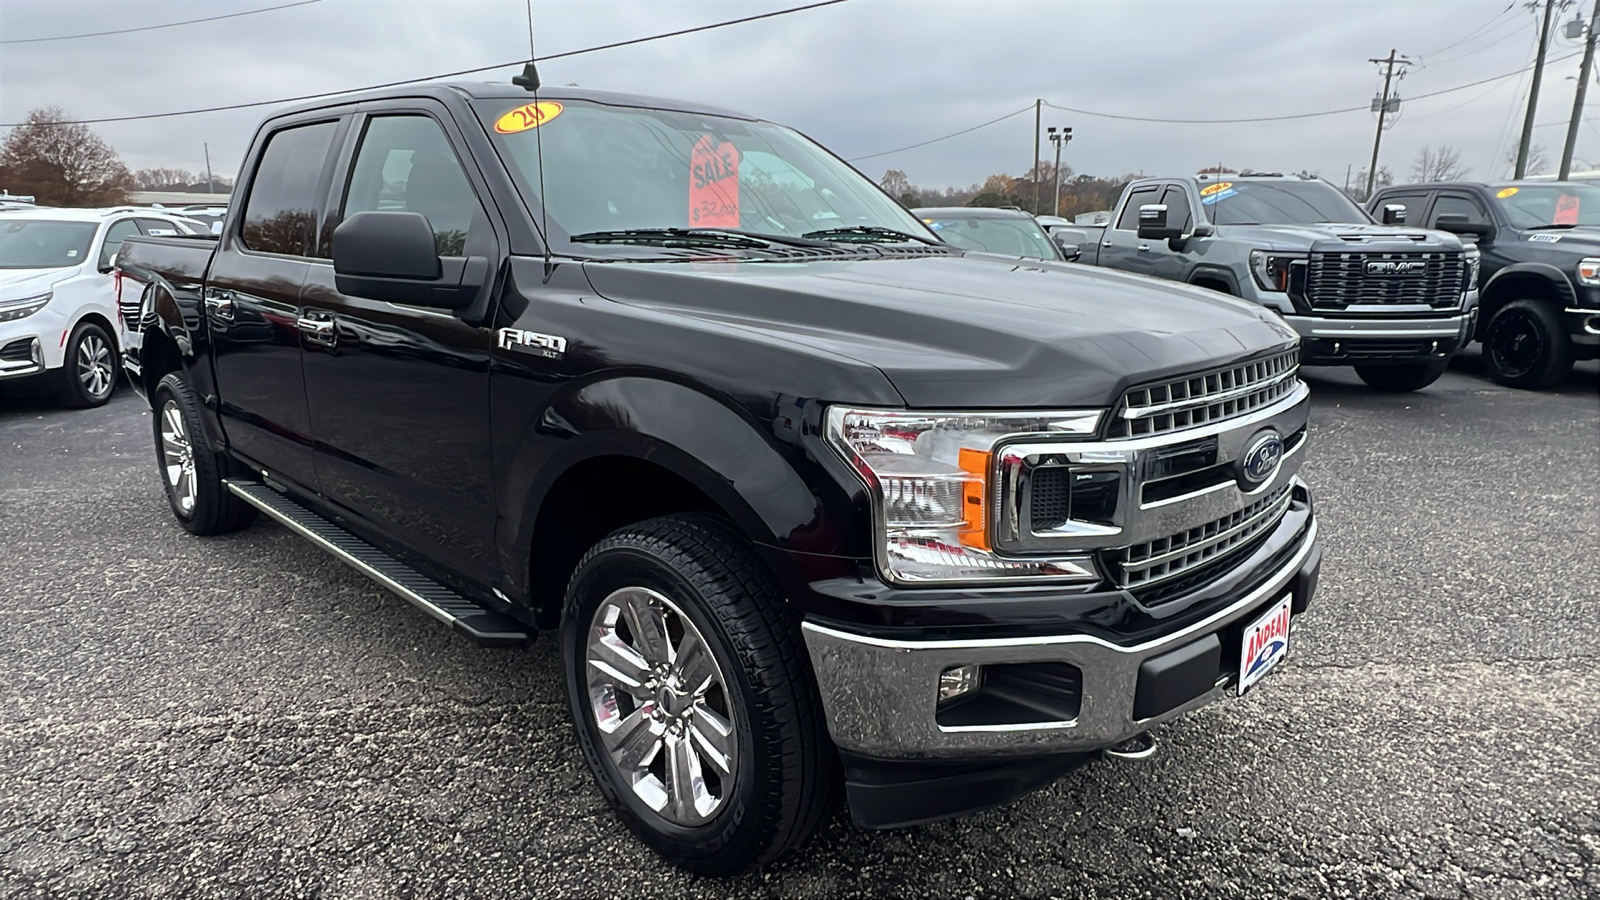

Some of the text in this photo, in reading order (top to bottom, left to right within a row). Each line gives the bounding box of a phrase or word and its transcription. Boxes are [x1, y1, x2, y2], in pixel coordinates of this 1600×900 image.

[511, 105, 546, 128] 20
[693, 152, 735, 189] SALE
[1367, 262, 1426, 274] GMC
[542, 350, 558, 359] XLT
[1257, 444, 1280, 474] Ford
[1244, 606, 1290, 674] ANDEAN
